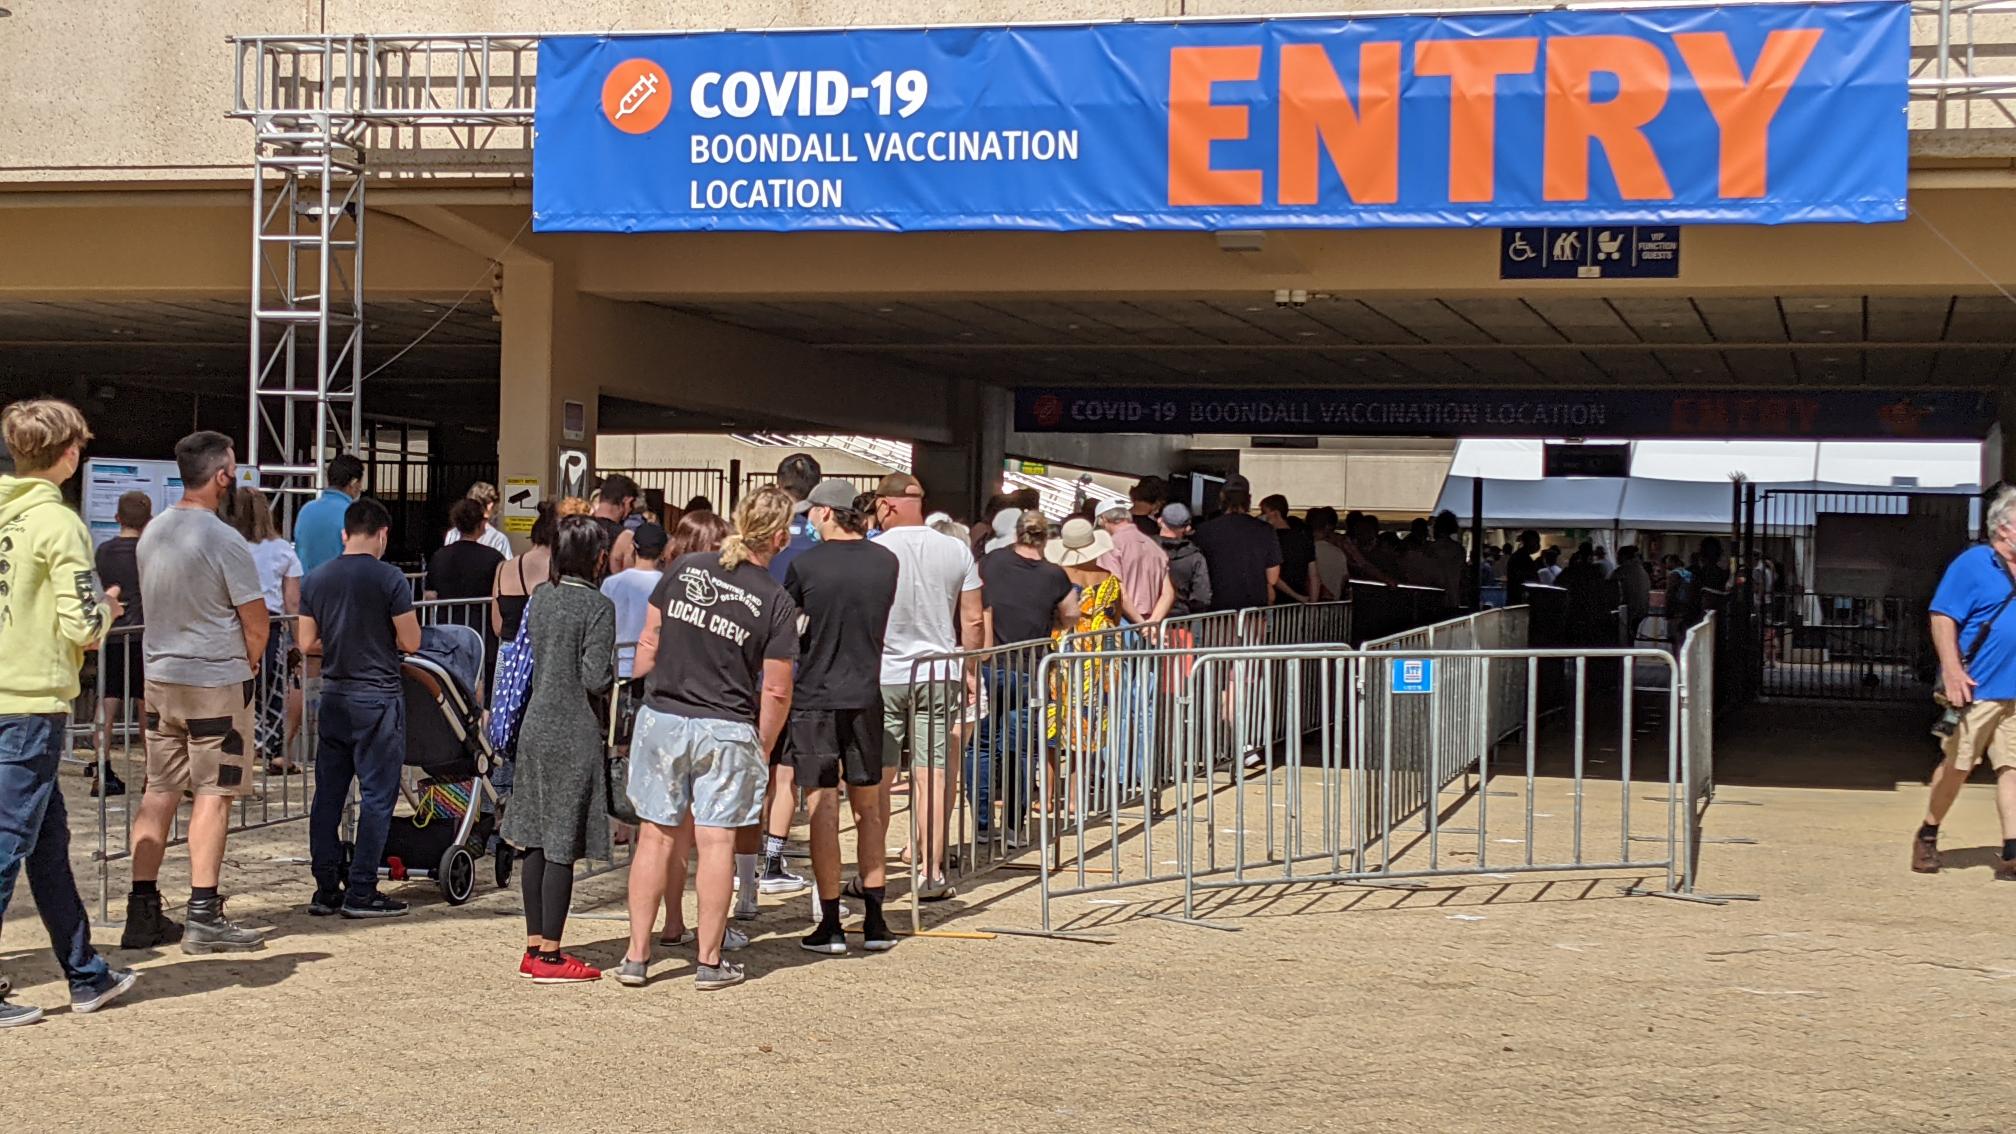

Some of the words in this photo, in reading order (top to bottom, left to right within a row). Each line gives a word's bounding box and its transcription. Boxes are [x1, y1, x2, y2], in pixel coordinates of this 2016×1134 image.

[690, 70, 928, 118] COVID-19
[1167, 28, 1823, 206] ENTRY
[690, 132, 859, 164] BOONDALL
[865, 129, 1079, 163] VACCINATION
[690, 179, 843, 209] LOCATION
[1638, 242, 1677, 250] FUNCTION
[1650, 233, 1665, 241] VIP
[1641, 251, 1673, 260] GUESTS
[1071, 401, 1177, 422] COVID-19
[1189, 401, 1313, 424] BOONDALL
[1320, 402, 1479, 425] VACCINATION
[1484, 402, 1607, 426] LOCATION
[711, 577, 744, 596] POINTING
[747, 593, 762, 606] AND
[720, 593, 760, 617] DESCRIBING
[667, 598, 706, 629] LOCAL
[708, 614, 751, 647] CREW
